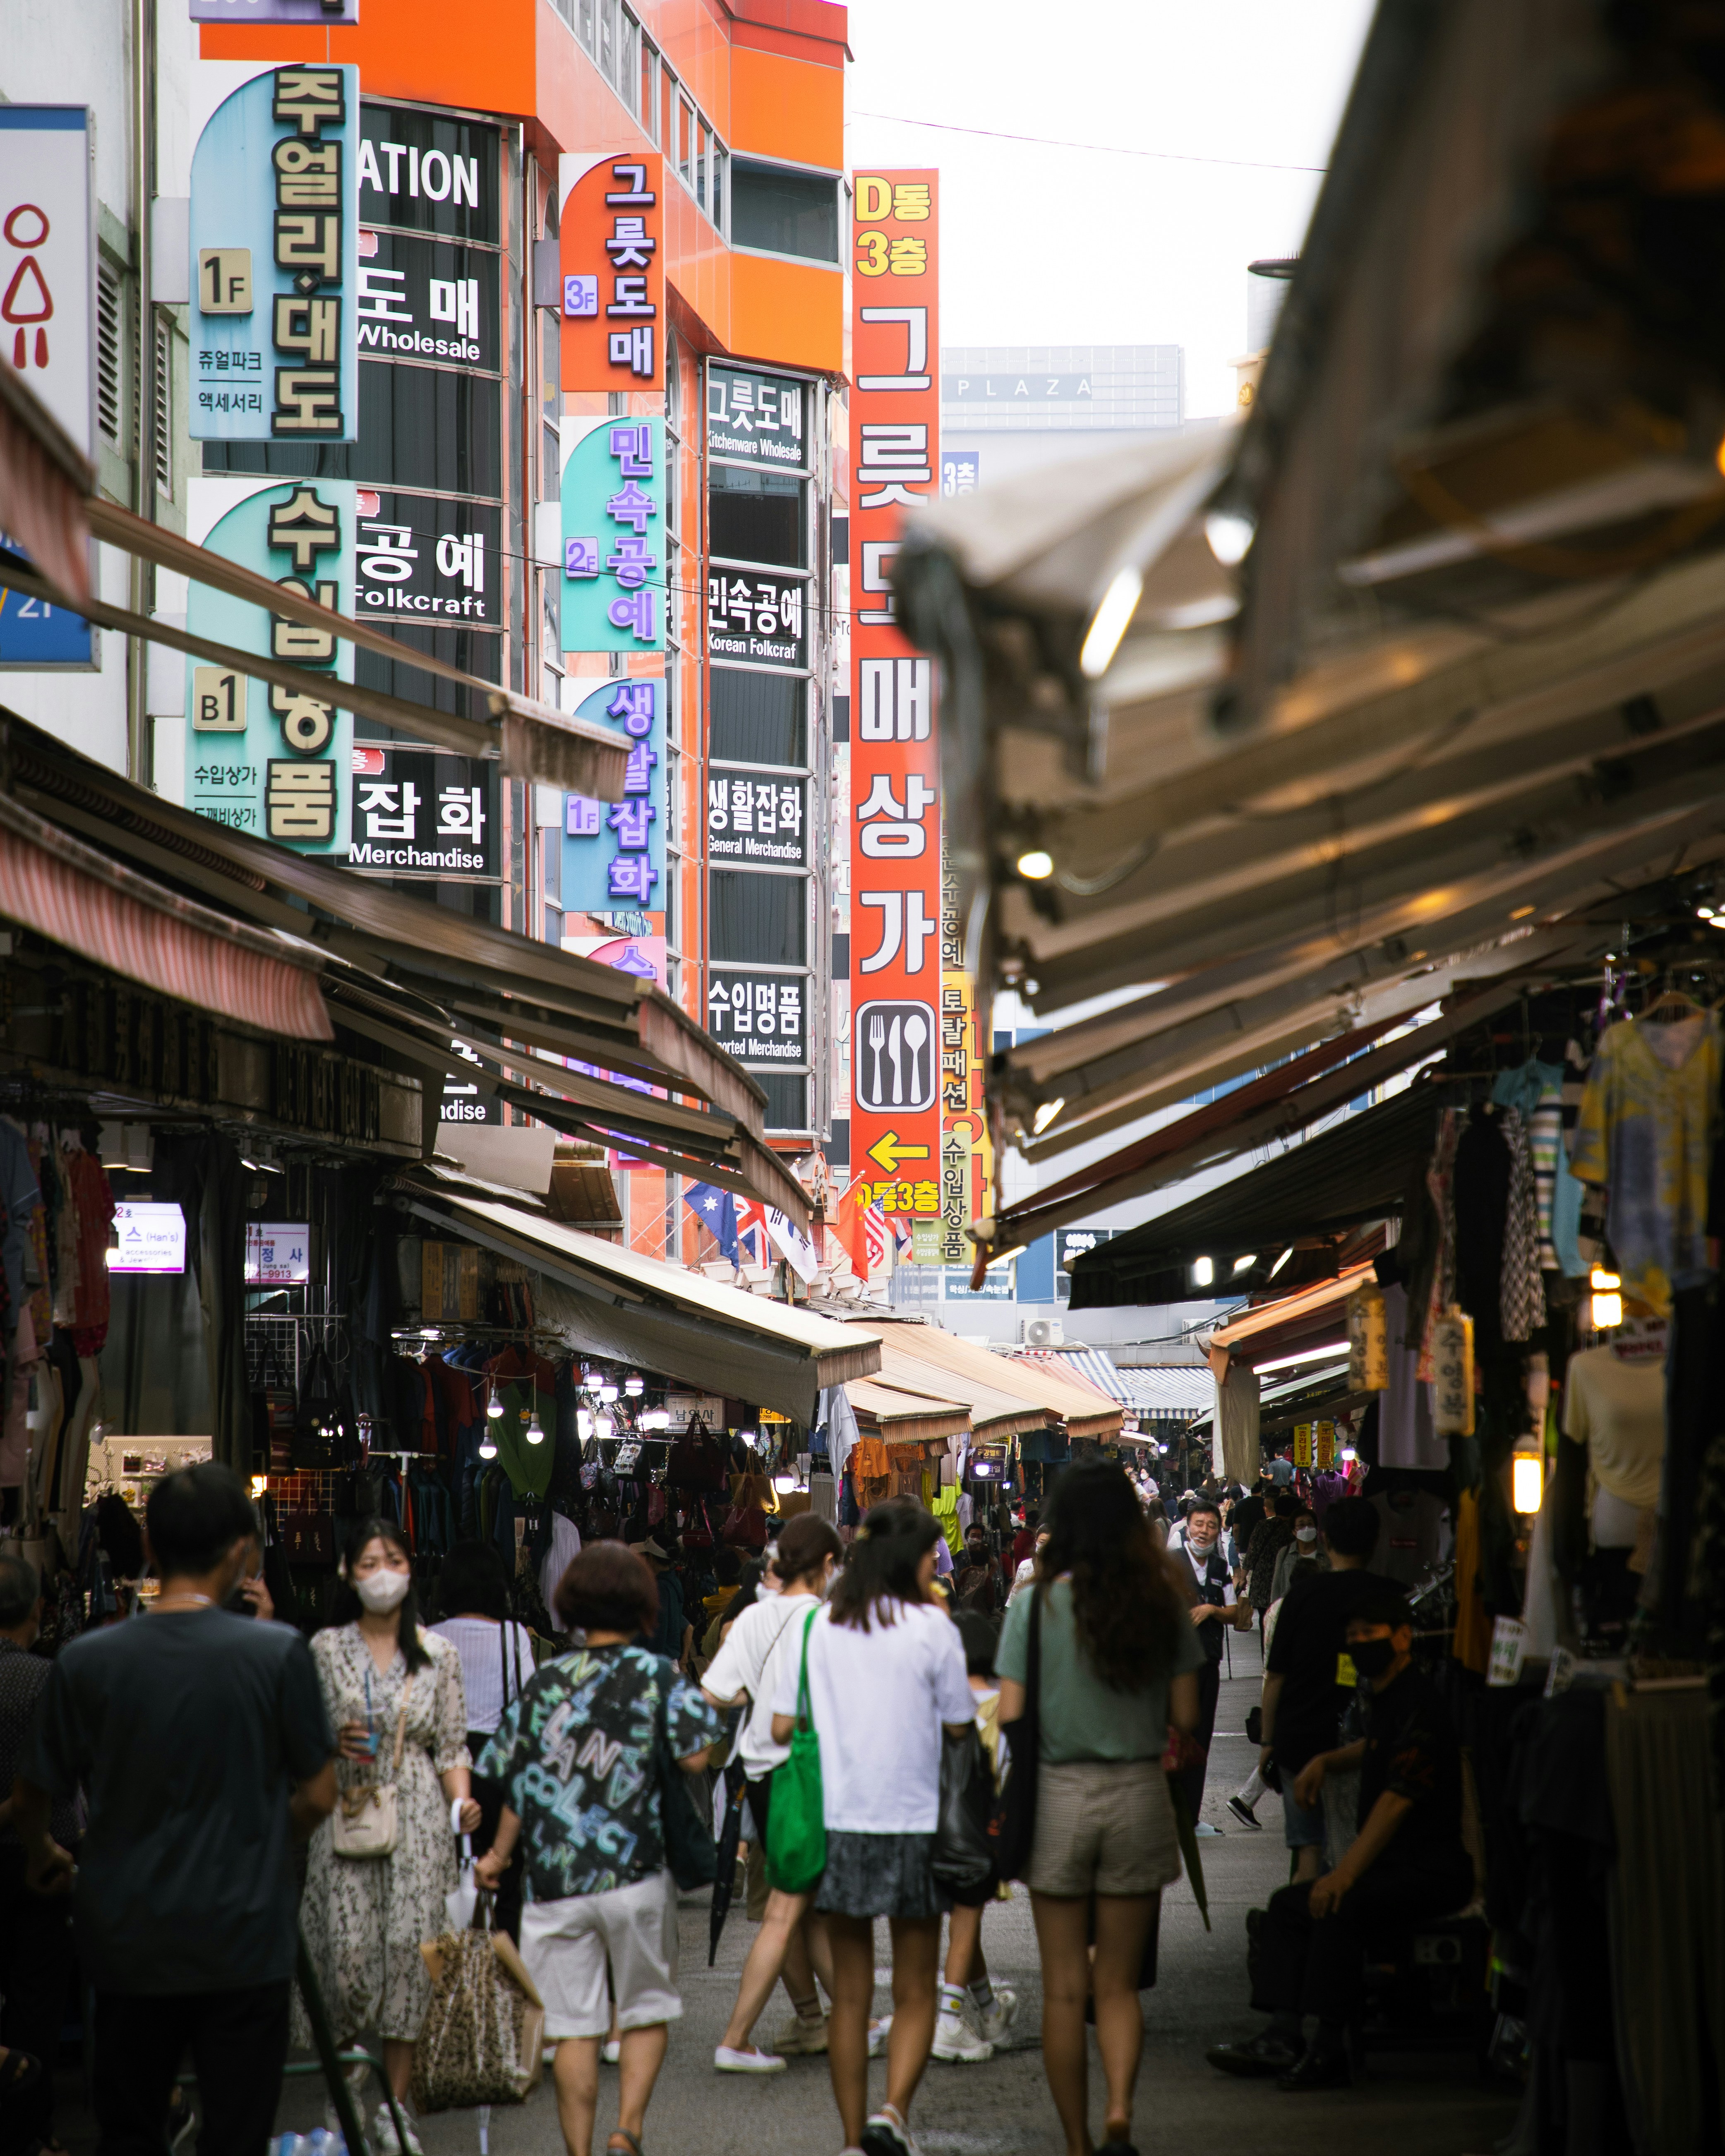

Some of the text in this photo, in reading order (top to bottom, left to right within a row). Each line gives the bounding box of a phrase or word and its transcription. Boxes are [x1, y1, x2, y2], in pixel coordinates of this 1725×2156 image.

[855, 176, 931, 222] D동
[605, 164, 656, 376] 그릇도매
[856, 230, 927, 277] 3층
[205, 256, 245, 303] 1F
[567, 280, 595, 309] 3F
[357, 324, 480, 360] Wholesale
[199, 350, 262, 371] 쥬얼파크
[199, 392, 262, 413] 액세서리
[958, 379, 1092, 396] PLAZA
[709, 379, 801, 439] 그릇도매
[760, 439, 801, 461] Wholesale
[606, 423, 657, 641] 민속공예
[355, 522, 483, 592] 공예
[569, 542, 596, 572] 2F
[355, 584, 485, 617] Folkcraft
[709, 577, 801, 638] 민속공예
[708, 633, 796, 659] Korean Folkcraf
[201, 675, 236, 721] B1
[194, 765, 257, 786] 수입상가
[357, 782, 486, 844] 잡화
[570, 800, 596, 830] 1F
[709, 779, 802, 836] 생활잡화
[349, 843, 484, 869] Merchandise
[708, 835, 802, 859] General Merchandise
[709, 981, 801, 1035] 수입명품
[749, 1038, 801, 1058] Merchandise
[943, 989, 967, 1110] 토탈패션
[940, 1136, 968, 1259] 수입상품
[146, 1231, 178, 1243] (Han's)
[916, 1233, 939, 1242] 수입상가
